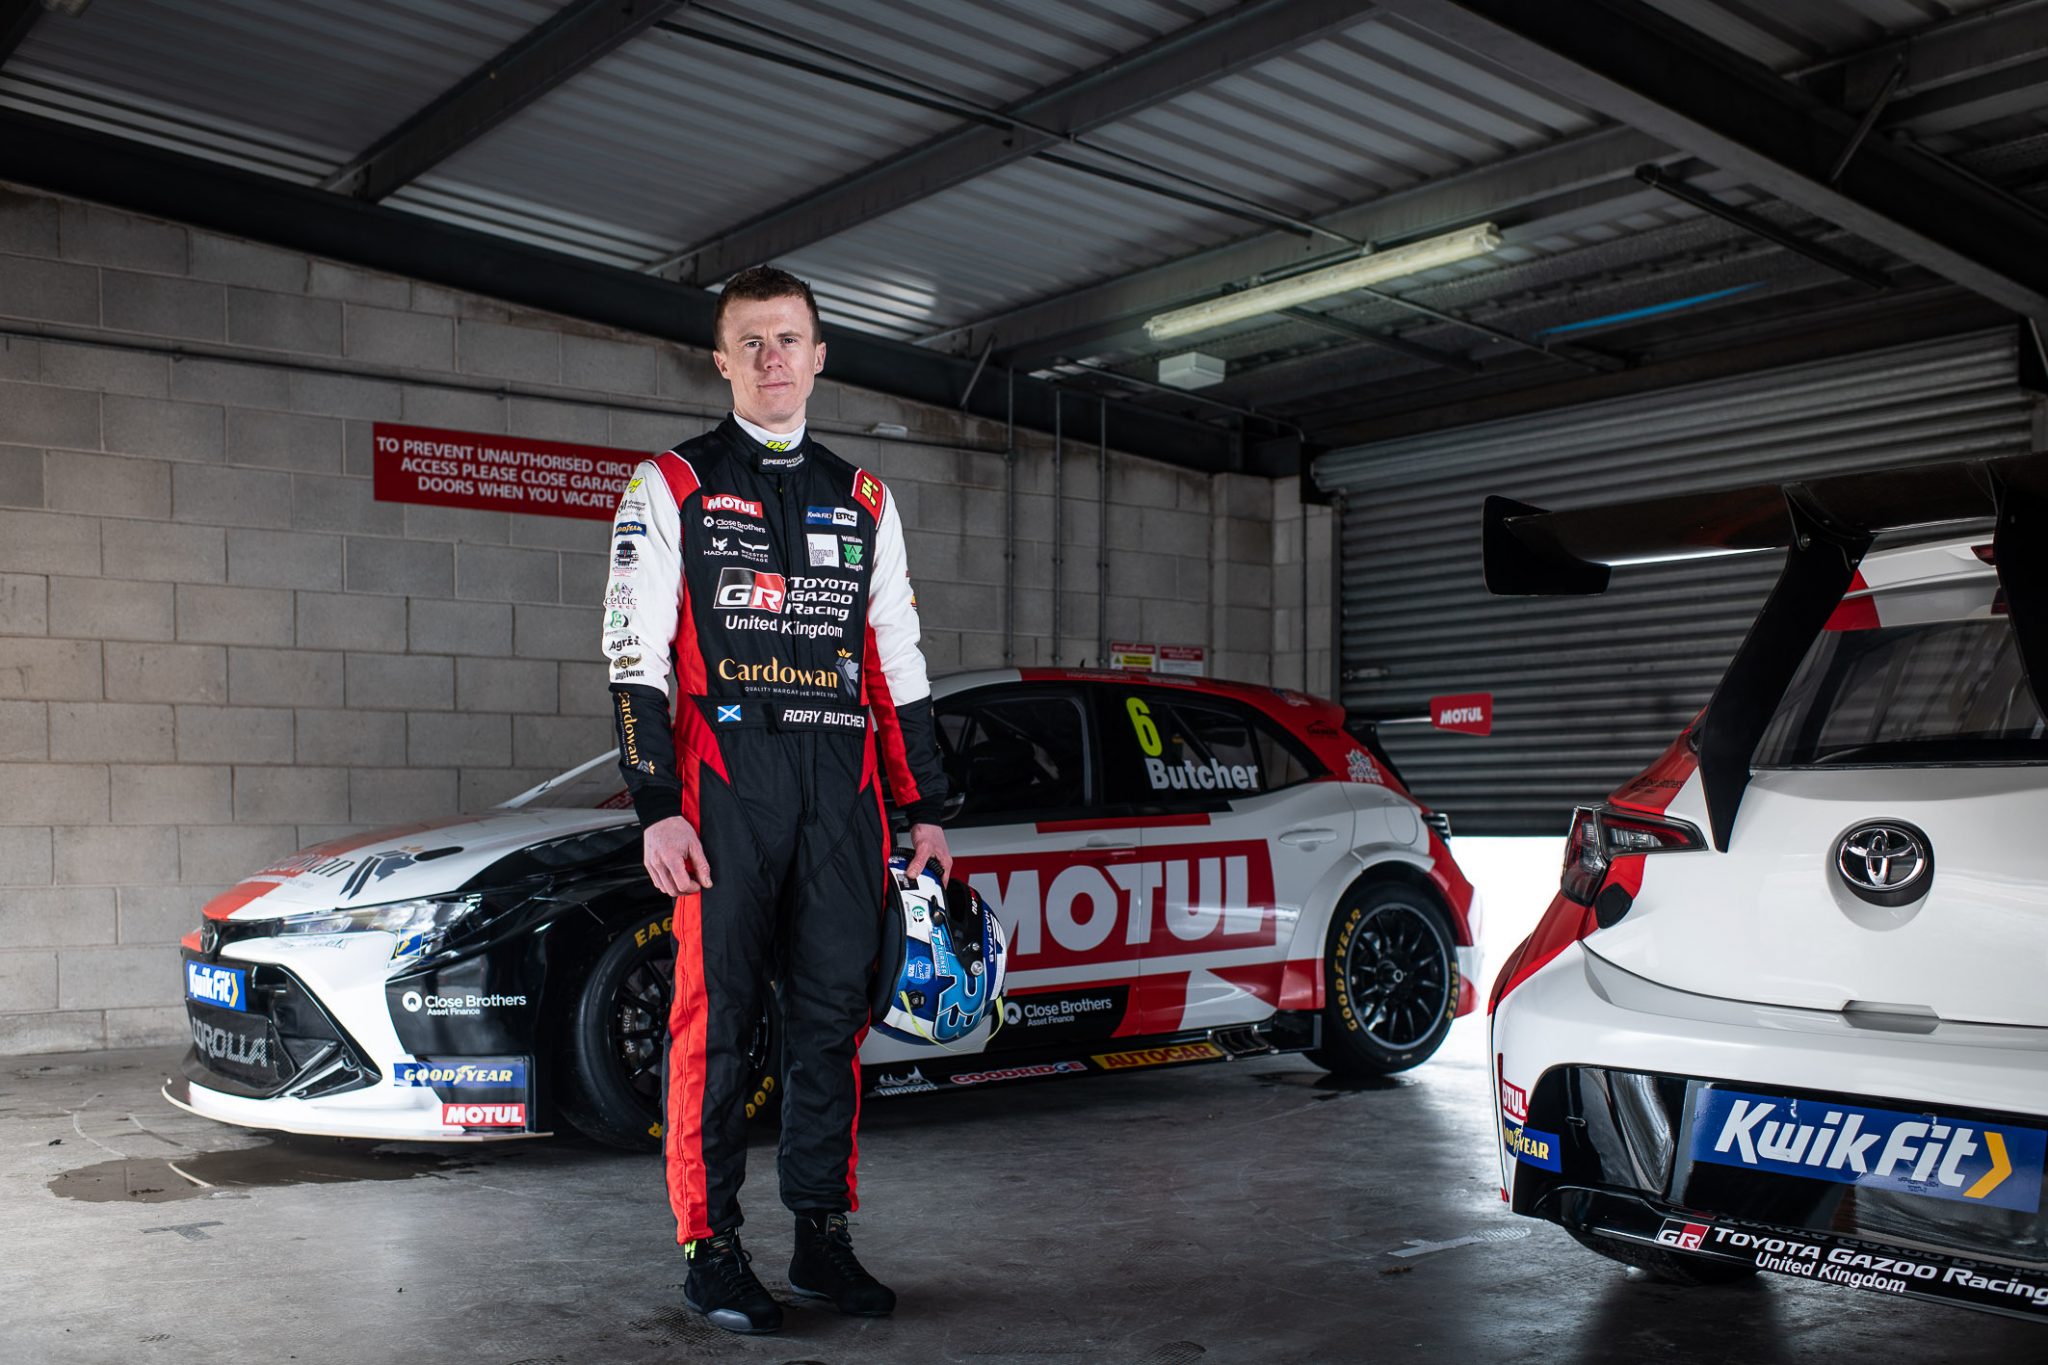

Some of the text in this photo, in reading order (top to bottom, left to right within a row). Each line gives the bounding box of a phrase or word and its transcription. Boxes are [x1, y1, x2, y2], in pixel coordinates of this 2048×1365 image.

[377, 437, 399, 452] TO
[403, 439, 474, 461] PREVENT
[478, 448, 593, 473] UNAUTHORISED
[401, 457, 459, 476] ACCESS
[462, 464, 517, 482] PLEASE
[521, 470, 567, 488] CLOSE
[418, 476, 474, 496] DOORS
[478, 483, 524, 500] WHEN
[527, 489, 558, 504] YOU
[562, 492, 615, 509] VACATE
[708, 497, 757, 515] MOTUL
[716, 519, 766, 534] Close Brothers
[788, 576, 859, 592] TOYOTA
[718, 584, 783, 611] GR
[787, 590, 853, 604] GAZOO
[785, 603, 850, 621] Racing
[725, 615, 843, 639] United Kingdom
[609, 636, 640, 652] Agrii
[718, 656, 838, 689] Cardowan
[783, 709, 865, 728] RORY BUTCHER
[1126, 697, 1162, 757] 6
[1440, 707, 1484, 725] MOTUL
[1144, 757, 1259, 790] Butcher
[968, 855, 1265, 956] MOTUL
[983, 909, 995, 963] HAD-FAB
[938, 946, 947, 974] TURNER
[1335, 908, 1362, 1031] GOODYEAR
[425, 994, 527, 1008] Close Brothers
[427, 1008, 480, 1016] Asset Finance
[1024, 998, 1112, 1018] Close Brothers
[1027, 1015, 1075, 1027] Asset Finance
[1105, 1045, 1214, 1067] AUTOCAR
[404, 1065, 513, 1085] GOODYEAR
[950, 1061, 1088, 1085] GOODRIDGE
[445, 1106, 522, 1124] MOTUL
[1657, 1229, 1701, 1250] GR
[1714, 1227, 1822, 1259] TOYOTA
[1827, 1247, 1938, 1280] GAZOO
[1943, 1266, 2048, 1306] Racing
[1755, 1251, 1907, 1293] United Kingdom
